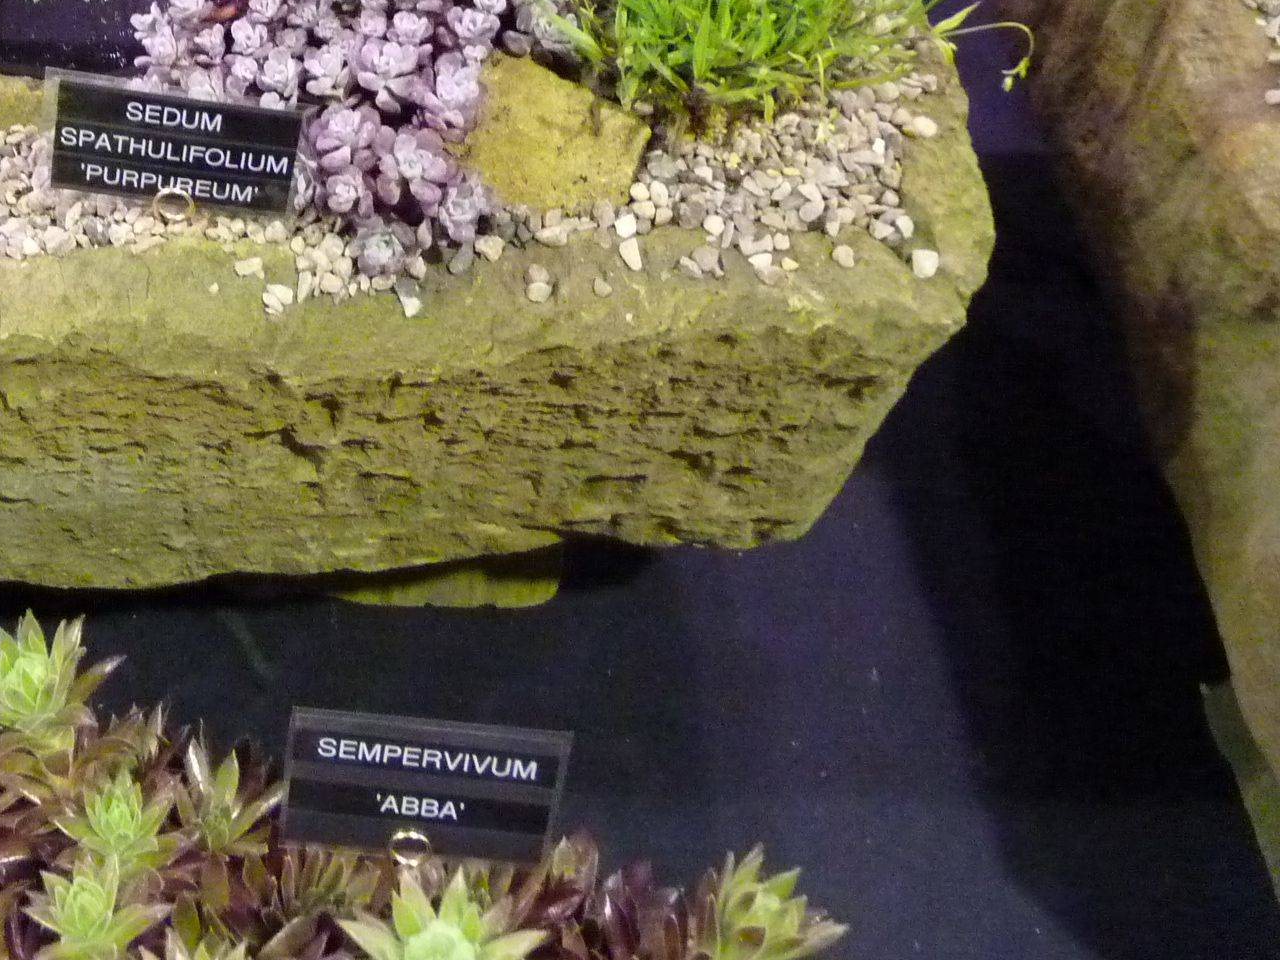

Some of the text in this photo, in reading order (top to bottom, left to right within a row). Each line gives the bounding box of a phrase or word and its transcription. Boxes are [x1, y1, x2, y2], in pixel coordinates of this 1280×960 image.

[126, 101, 222, 132] SEDUM
[60, 127, 289, 174] SPATHULIFOLIUM
[81, 163, 259, 202] 'PURPUREUM'
[317, 737, 537, 780] SEMPERVIVUM
[376, 793, 464, 820] 'ABBA'
